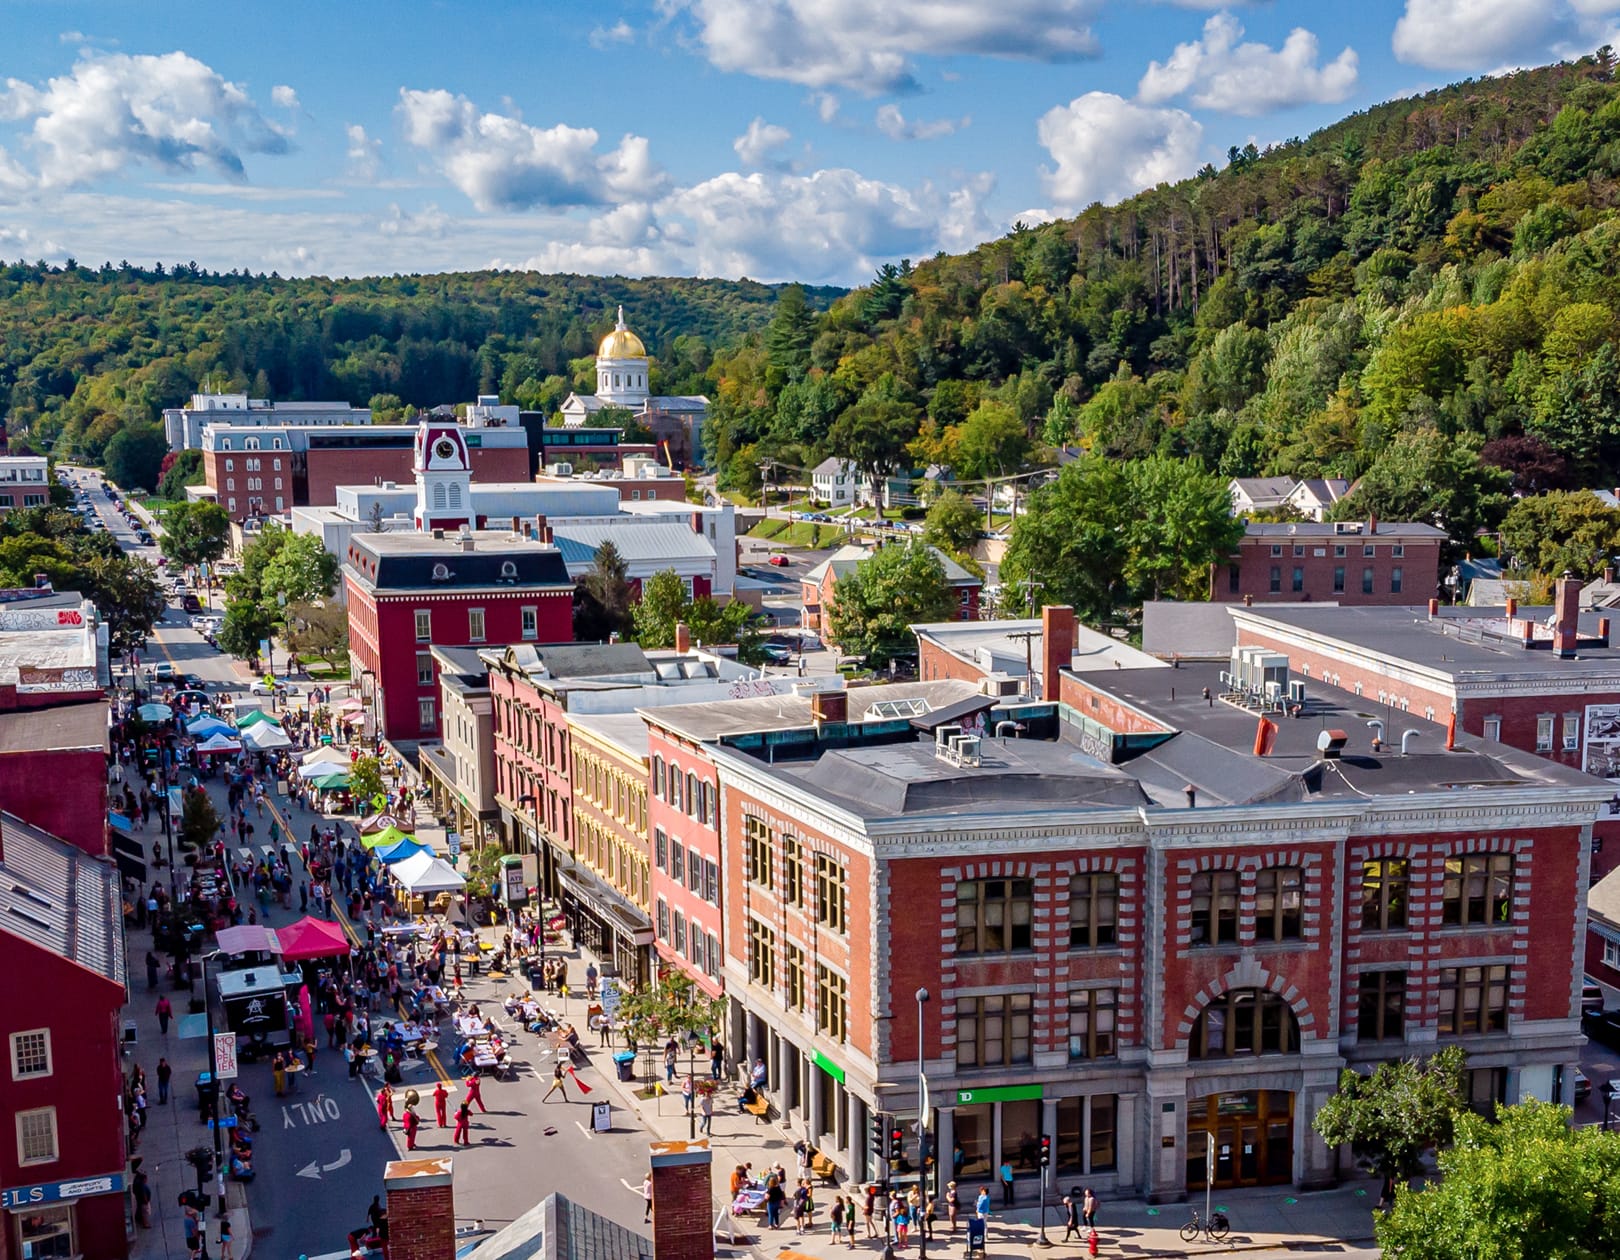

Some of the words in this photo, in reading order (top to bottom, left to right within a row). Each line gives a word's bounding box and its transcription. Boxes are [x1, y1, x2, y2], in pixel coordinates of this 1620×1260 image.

[216, 1036, 234, 1046] MO
[218, 1062, 236, 1072] IER
[959, 1092, 972, 1102] TD
[281, 1098, 340, 1129] ONLY
